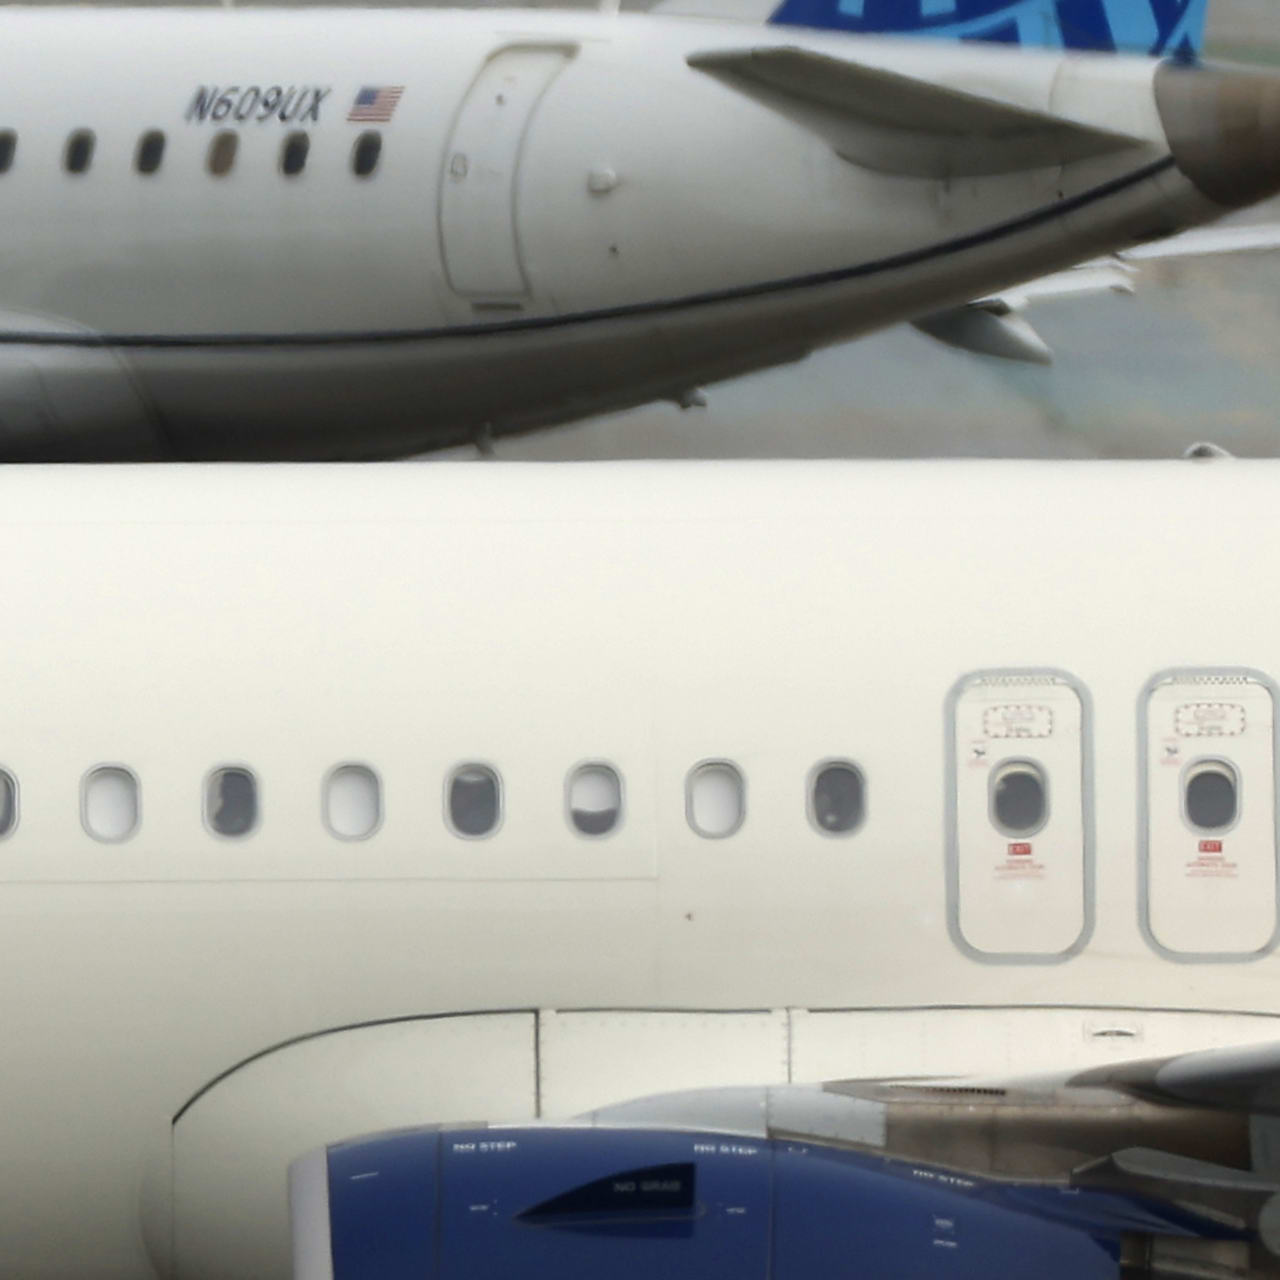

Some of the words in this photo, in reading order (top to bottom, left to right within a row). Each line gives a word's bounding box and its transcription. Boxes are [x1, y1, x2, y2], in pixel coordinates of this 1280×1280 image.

[185, 85, 332, 122] N609UX
[453, 1143, 476, 1153] NO
[479, 1141, 517, 1152] STEP
[694, 1143, 716, 1153] NO
[720, 1145, 758, 1156] STEP
[614, 1181, 635, 1192] NO
